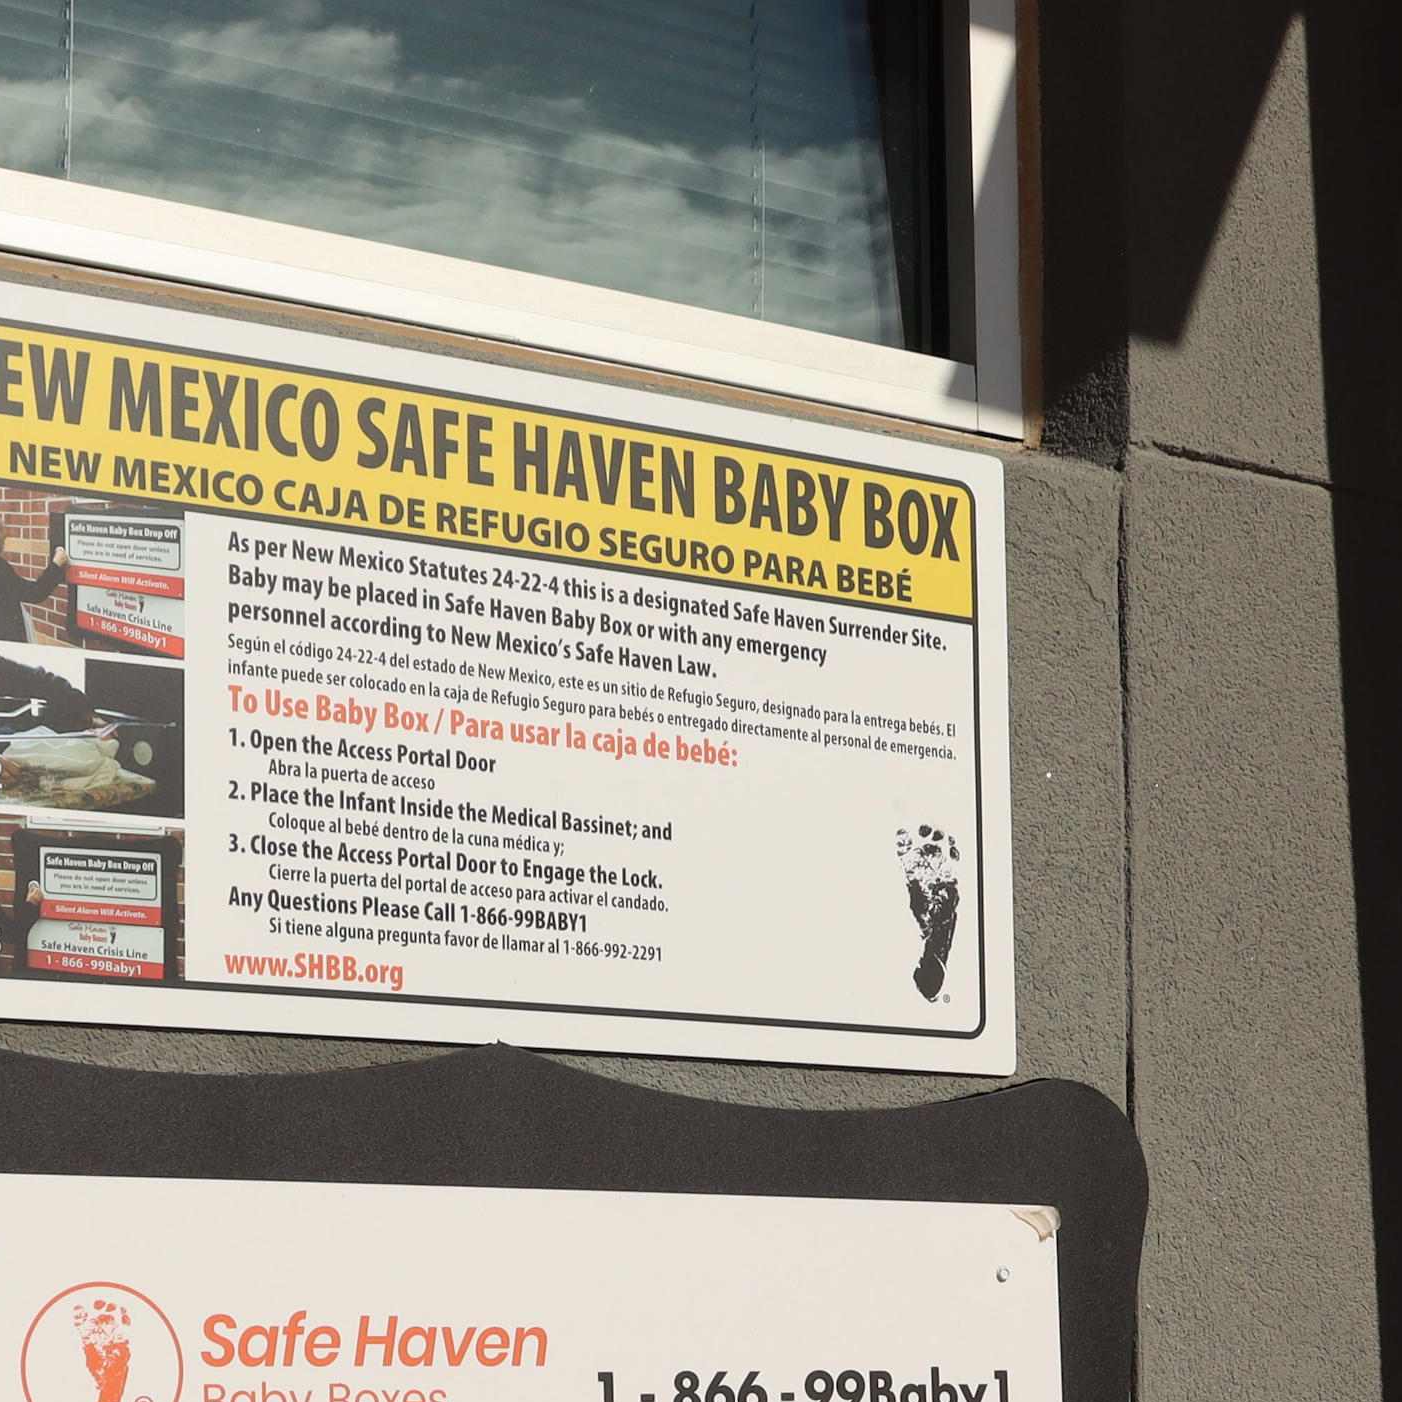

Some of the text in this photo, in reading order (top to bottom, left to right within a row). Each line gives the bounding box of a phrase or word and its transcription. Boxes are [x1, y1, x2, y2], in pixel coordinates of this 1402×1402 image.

[109, 356, 340, 462] MEXICO
[356, 397, 495, 487] SAFE
[513, 421, 695, 519] HAVEN
[714, 455, 850, 543] BABY
[863, 481, 961, 562] BOX
[10, 441, 913, 603] NEW MEXICO CAJA DE REFUGIO SEGURO PARA BEBÉ
[228, 563, 827, 668] Baby may be placed in Safe Haven Baby Box or with any emergency
[228, 601, 326, 629] personnel
[330, 614, 422, 646] according
[426, 623, 446, 644] to
[451, 624, 491, 649] New
[575, 641, 614, 665] Safe
[618, 646, 673, 673] Haven
[677, 654, 717, 678] Law.
[227, 633, 956, 738] Según el código 24-22-4 del estado de New Mexico, este es un sitio de Refugio Seguro, designado para la entrega bebés. El
[227, 684, 258, 714] To
[265, 688, 309, 720] Use
[316, 694, 378, 734] Baby
[384, 701, 429, 733] Box
[450, 709, 504, 741] Para
[510, 722, 561, 747] usar
[565, 722, 586, 750] la
[592, 727, 637, 761] caja
[642, 731, 670, 760] de
[676, 735, 738, 767] bebé:
[229, 727, 496, 773] 1. Open the Access Portal Door
[268, 758, 436, 791] Abra la puerta de acceso
[228, 885, 587, 933] Any Questions Please Call 1-866-99BABY1
[41, 940, 148, 959] Safe Haven Crisis Line
[269, 917, 662, 962] Si tiene alguna pregunta favor de llamar al 1-866-992-2291
[224, 952, 403, 992] www.SHBB.org
[200, 1310, 548, 1368] Safe Haven
